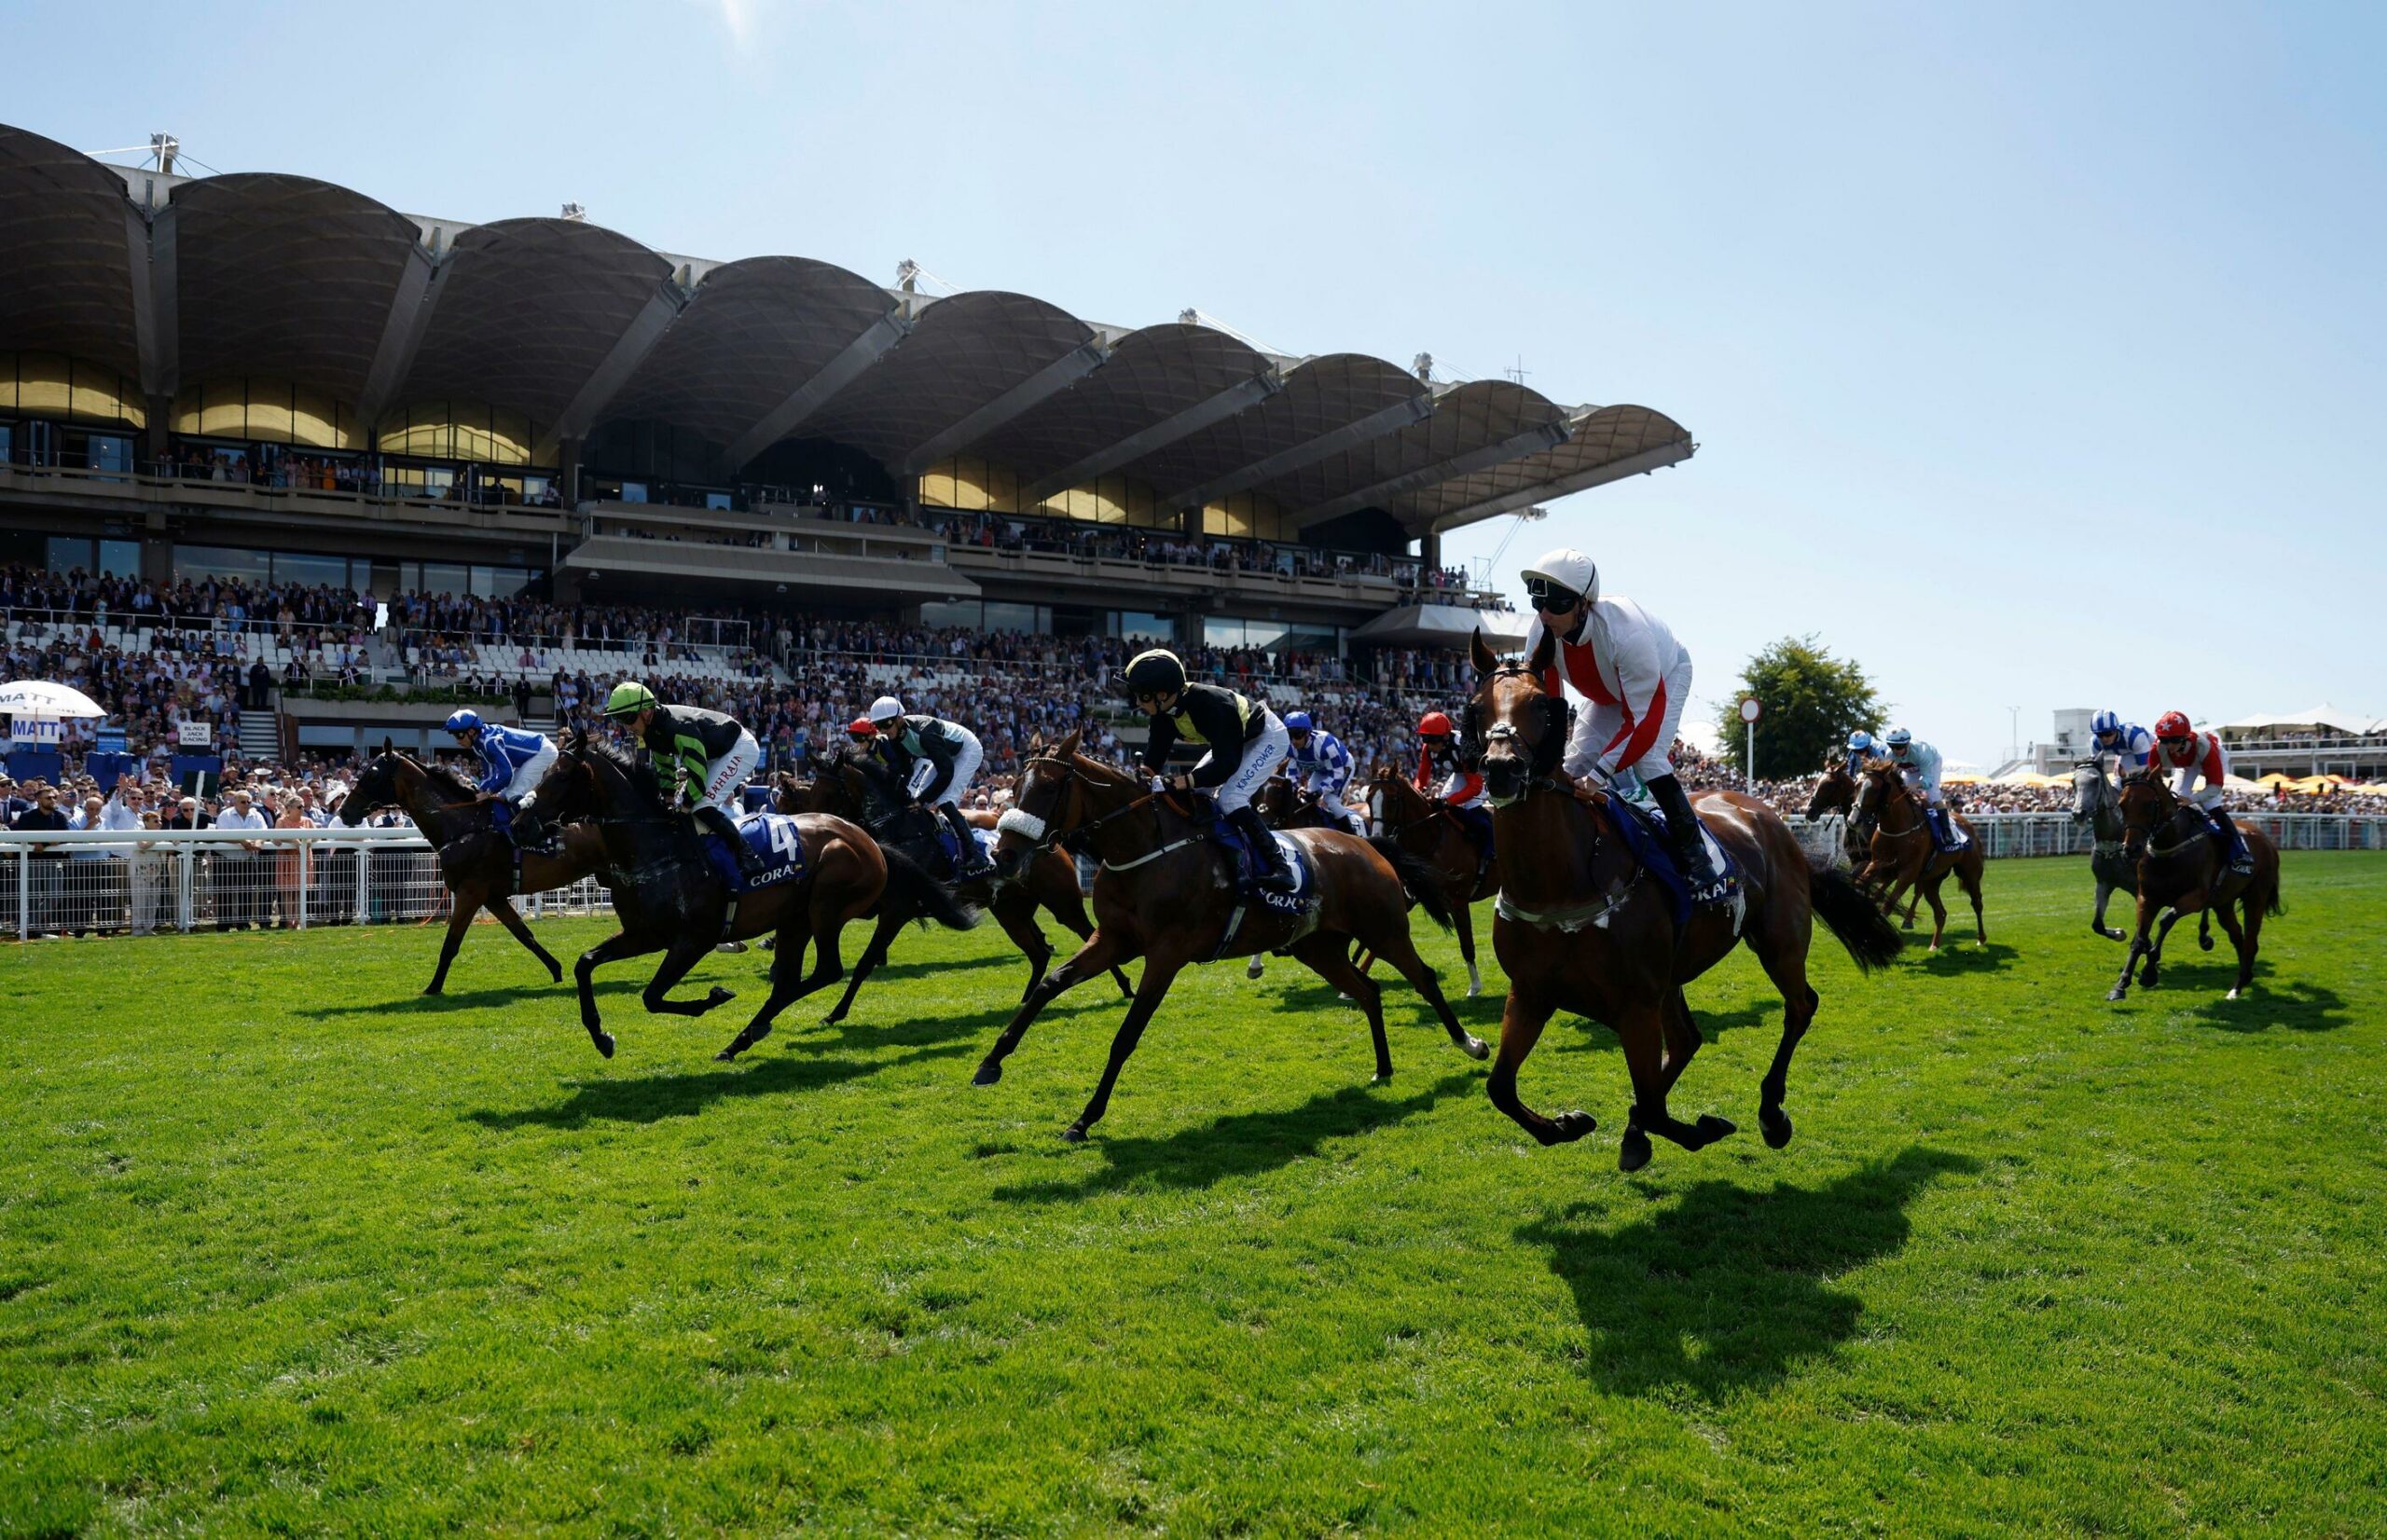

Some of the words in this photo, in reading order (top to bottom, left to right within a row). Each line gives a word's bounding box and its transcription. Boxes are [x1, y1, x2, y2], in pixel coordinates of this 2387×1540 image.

[13, 721, 58, 736] MATT
[706, 755, 742, 800] BAHRAIN
[1235, 768, 1255, 791] KING
[1251, 744, 1276, 772] POWER
[768, 816, 798, 861] 4
[750, 864, 795, 887] CORAL
